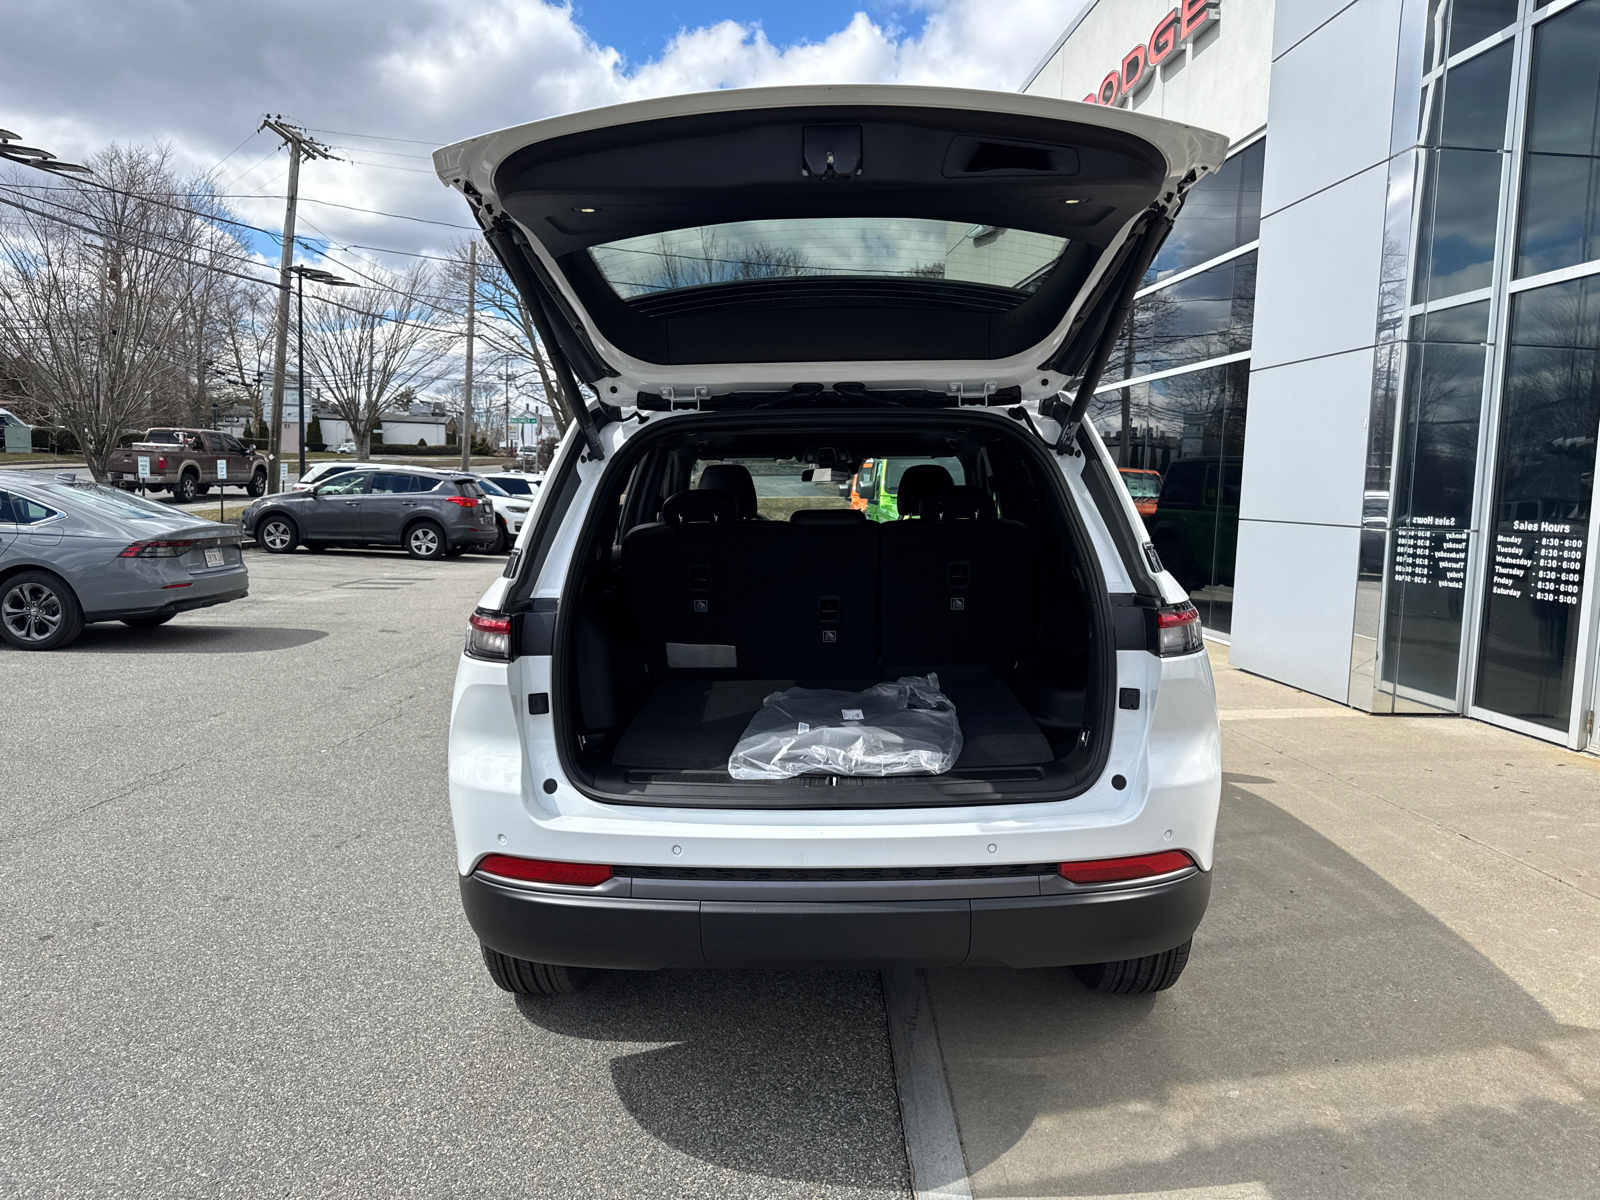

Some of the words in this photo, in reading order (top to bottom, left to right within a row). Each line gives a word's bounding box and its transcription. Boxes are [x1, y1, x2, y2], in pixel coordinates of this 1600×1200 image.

[1082, 0, 1210, 107] ODGE
[1513, 520, 1538, 531] Sales
[1540, 522, 1570, 533] Hours
[1497, 535, 1522, 545] Monday
[1496, 545, 1523, 555] Tuesday
[1496, 555, 1532, 567] Wednesday
[1495, 566, 1524, 577] Thursday
[1493, 576, 1513, 586] Friday
[1493, 586, 1521, 598] Saturday
